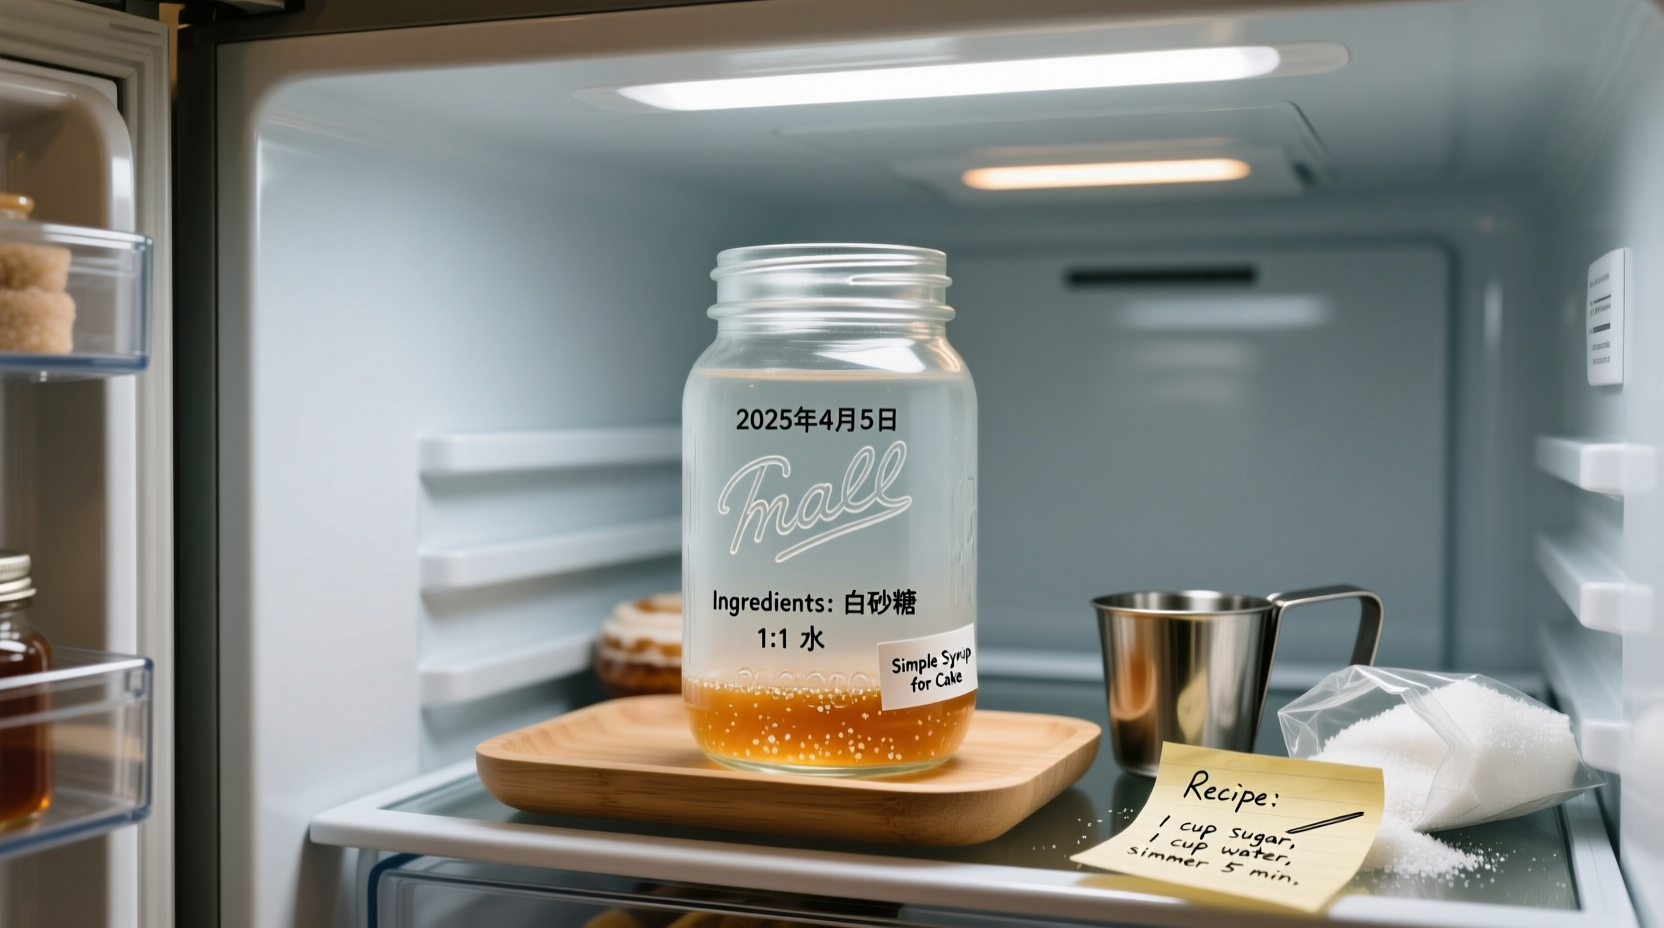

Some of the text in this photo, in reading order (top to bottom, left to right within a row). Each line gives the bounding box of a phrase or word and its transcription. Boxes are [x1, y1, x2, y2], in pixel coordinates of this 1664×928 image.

[736, 406, 897, 434] 2025年4月5日
[712, 588, 917, 617] Ingredients: 白砂糖
[757, 625, 825, 652] 1:1 水
[891, 646, 972, 675] Simple Syrup
[910, 670, 963, 693] for Cake
[1183, 769, 1280, 813] Recipe:
[1179, 821, 1217, 841] cup
[1228, 827, 1296, 850] sugar,
[1126, 844, 1300, 886] simmer 5 min.
[1170, 838, 1208, 856] cup
[1220, 845, 1292, 867] water,
